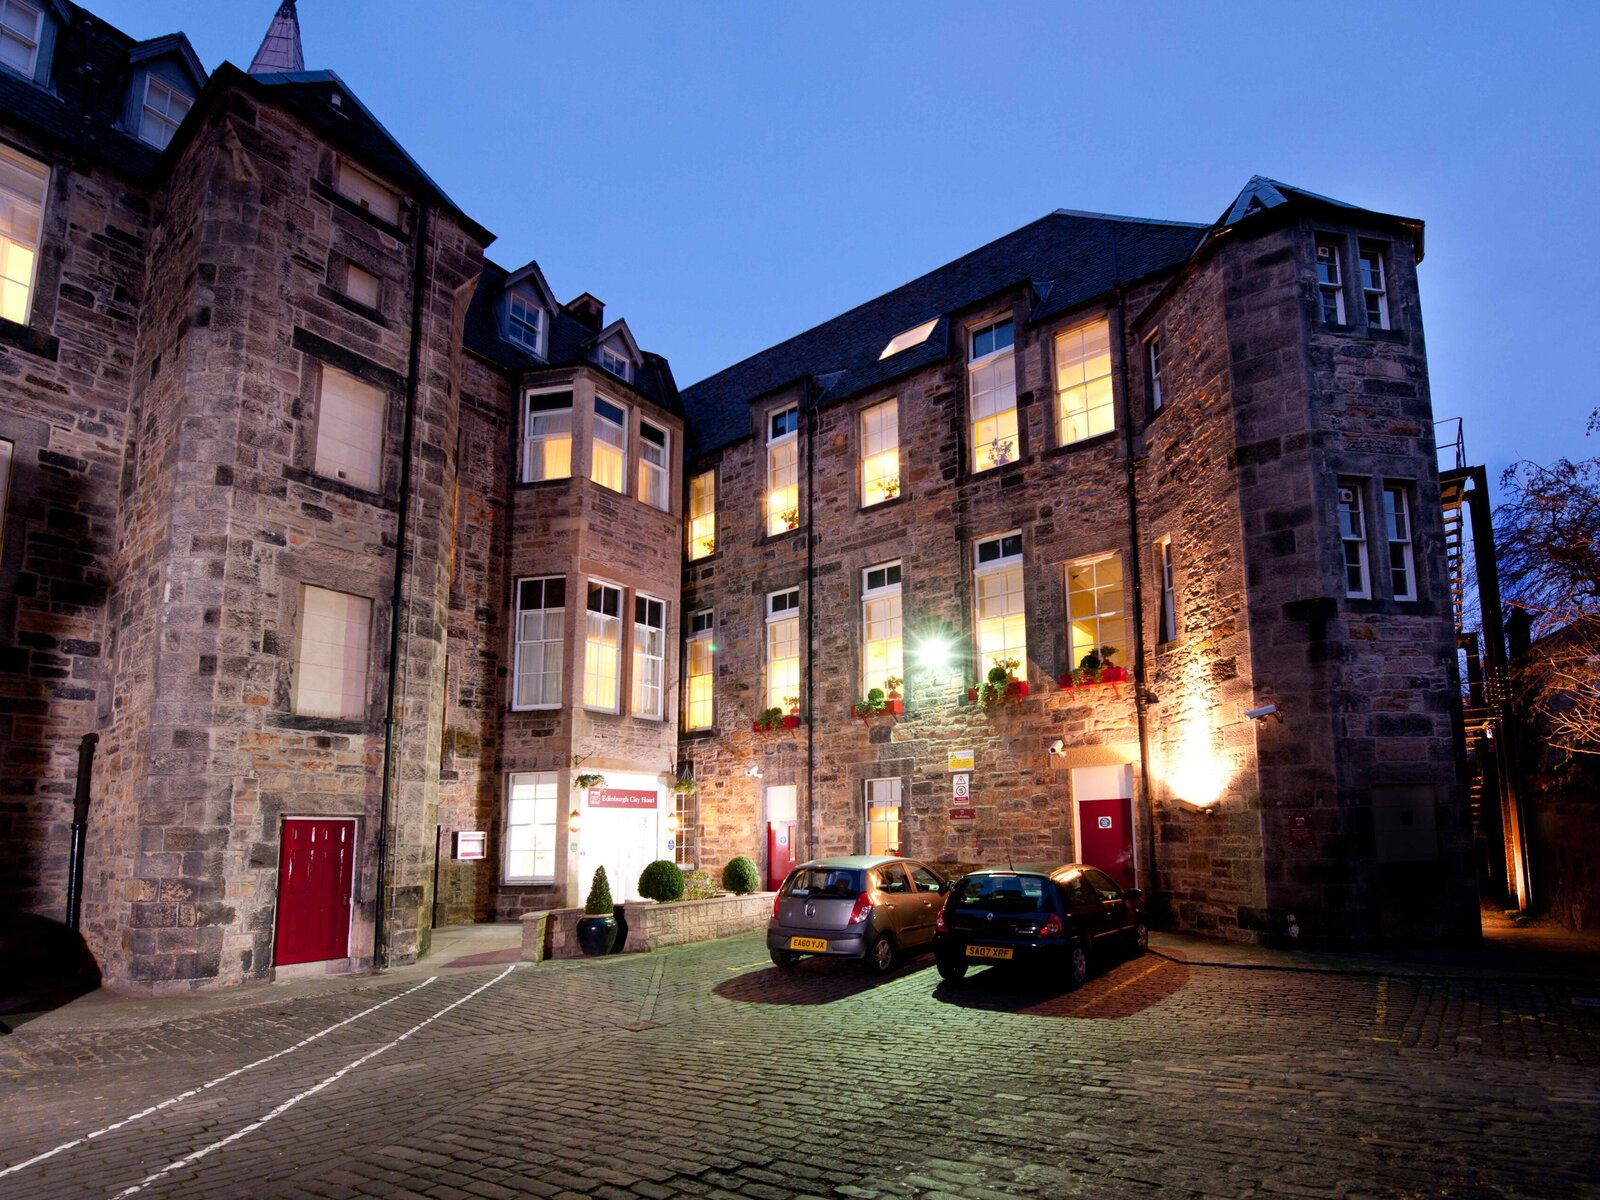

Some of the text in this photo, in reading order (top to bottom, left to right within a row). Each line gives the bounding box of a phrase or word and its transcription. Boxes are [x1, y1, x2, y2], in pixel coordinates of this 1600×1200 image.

[601, 794, 629, 803] Edinburgh
[630, 796, 640, 804] City
[793, 939, 825, 948] EA60 YJX
[969, 946, 1009, 957] SA07 XRF
